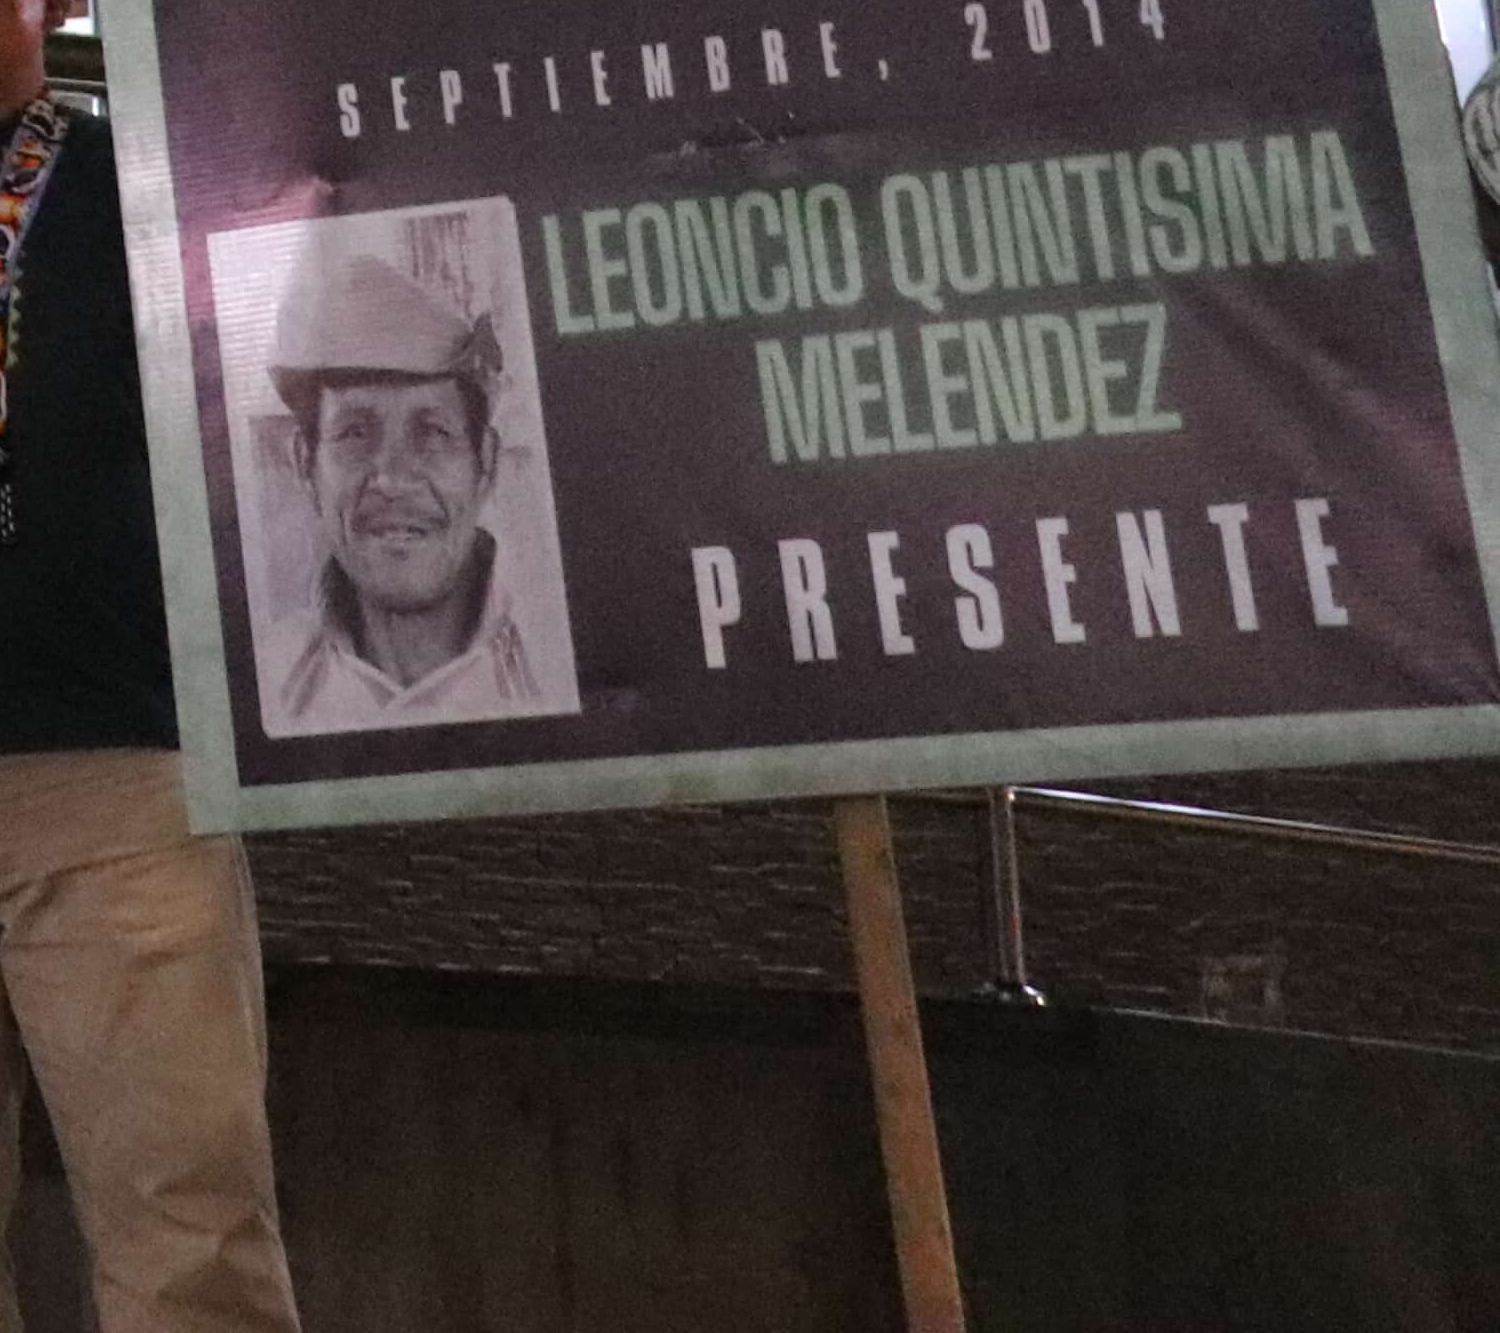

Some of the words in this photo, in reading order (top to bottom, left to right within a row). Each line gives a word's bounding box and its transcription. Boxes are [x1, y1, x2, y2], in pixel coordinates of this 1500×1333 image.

[336, 21, 891, 138] SEPTIEMBRE,
[542, 183, 866, 335] LEONCIO
[878, 130, 1377, 314] QUINTISIMA
[754, 301, 1184, 465] MELENDEZ
[690, 497, 1350, 670] PRESENTE
